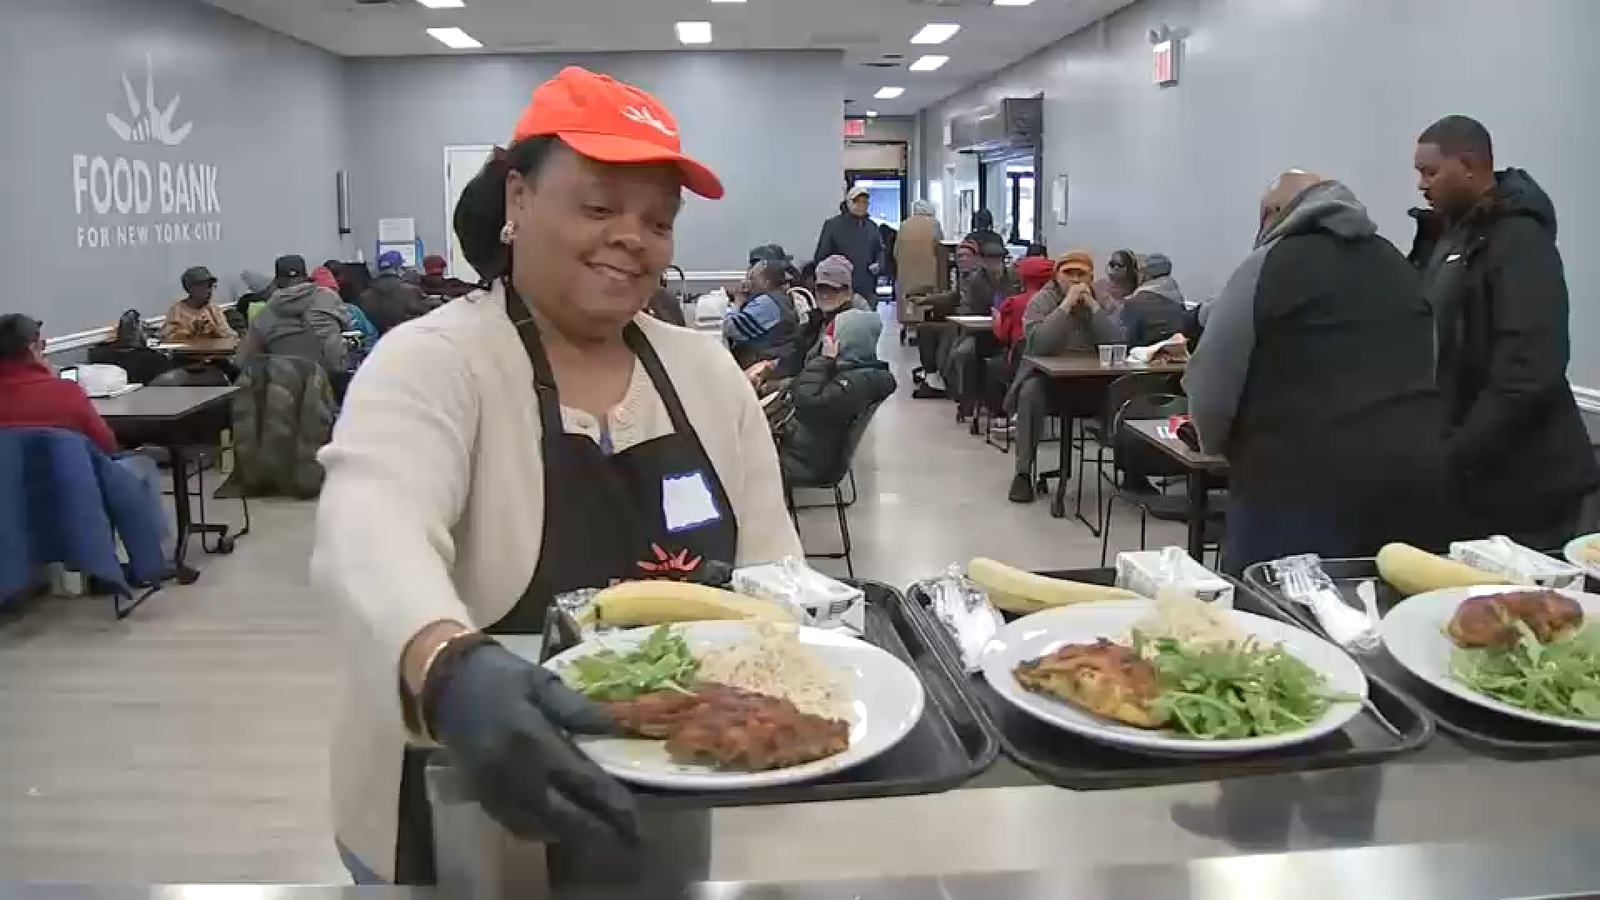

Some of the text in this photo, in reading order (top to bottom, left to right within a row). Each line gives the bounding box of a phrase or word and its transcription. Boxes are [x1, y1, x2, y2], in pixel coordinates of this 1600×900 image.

[72, 154, 221, 214] FOOD BANK
[77, 226, 110, 248] FOR
[117, 225, 149, 245] NEW
[154, 222, 190, 243] YORK
